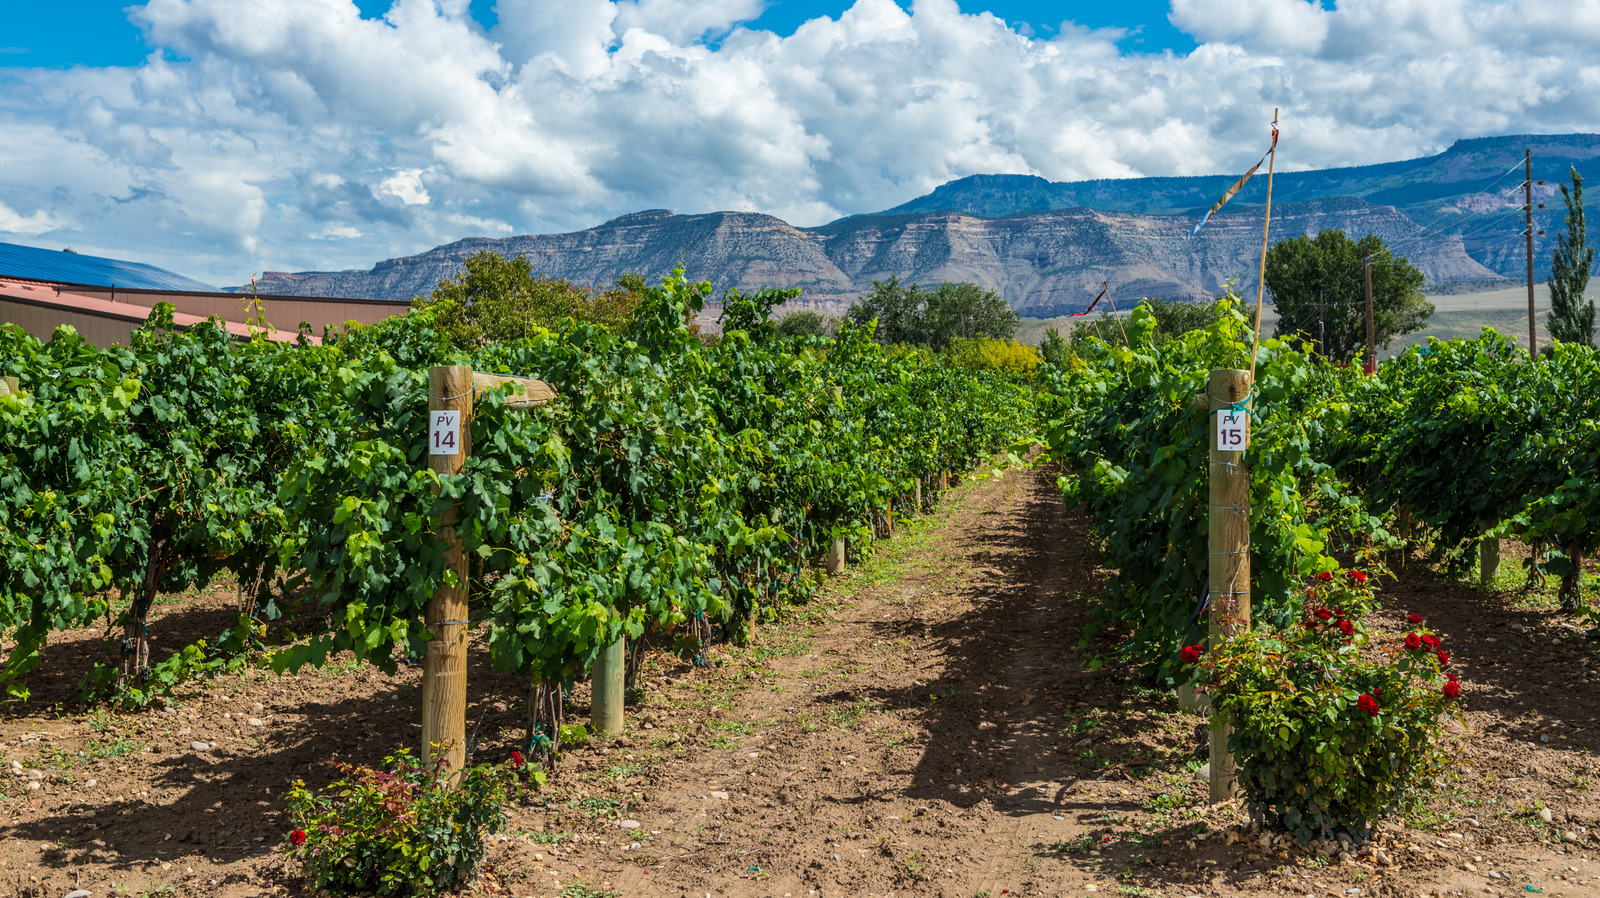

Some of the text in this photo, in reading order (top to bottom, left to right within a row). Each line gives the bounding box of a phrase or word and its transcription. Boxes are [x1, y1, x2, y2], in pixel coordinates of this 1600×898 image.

[437, 416, 454, 426] PV
[1223, 415, 1240, 425] PV
[433, 430, 455, 448] 14
[1221, 429, 1242, 445] 15
